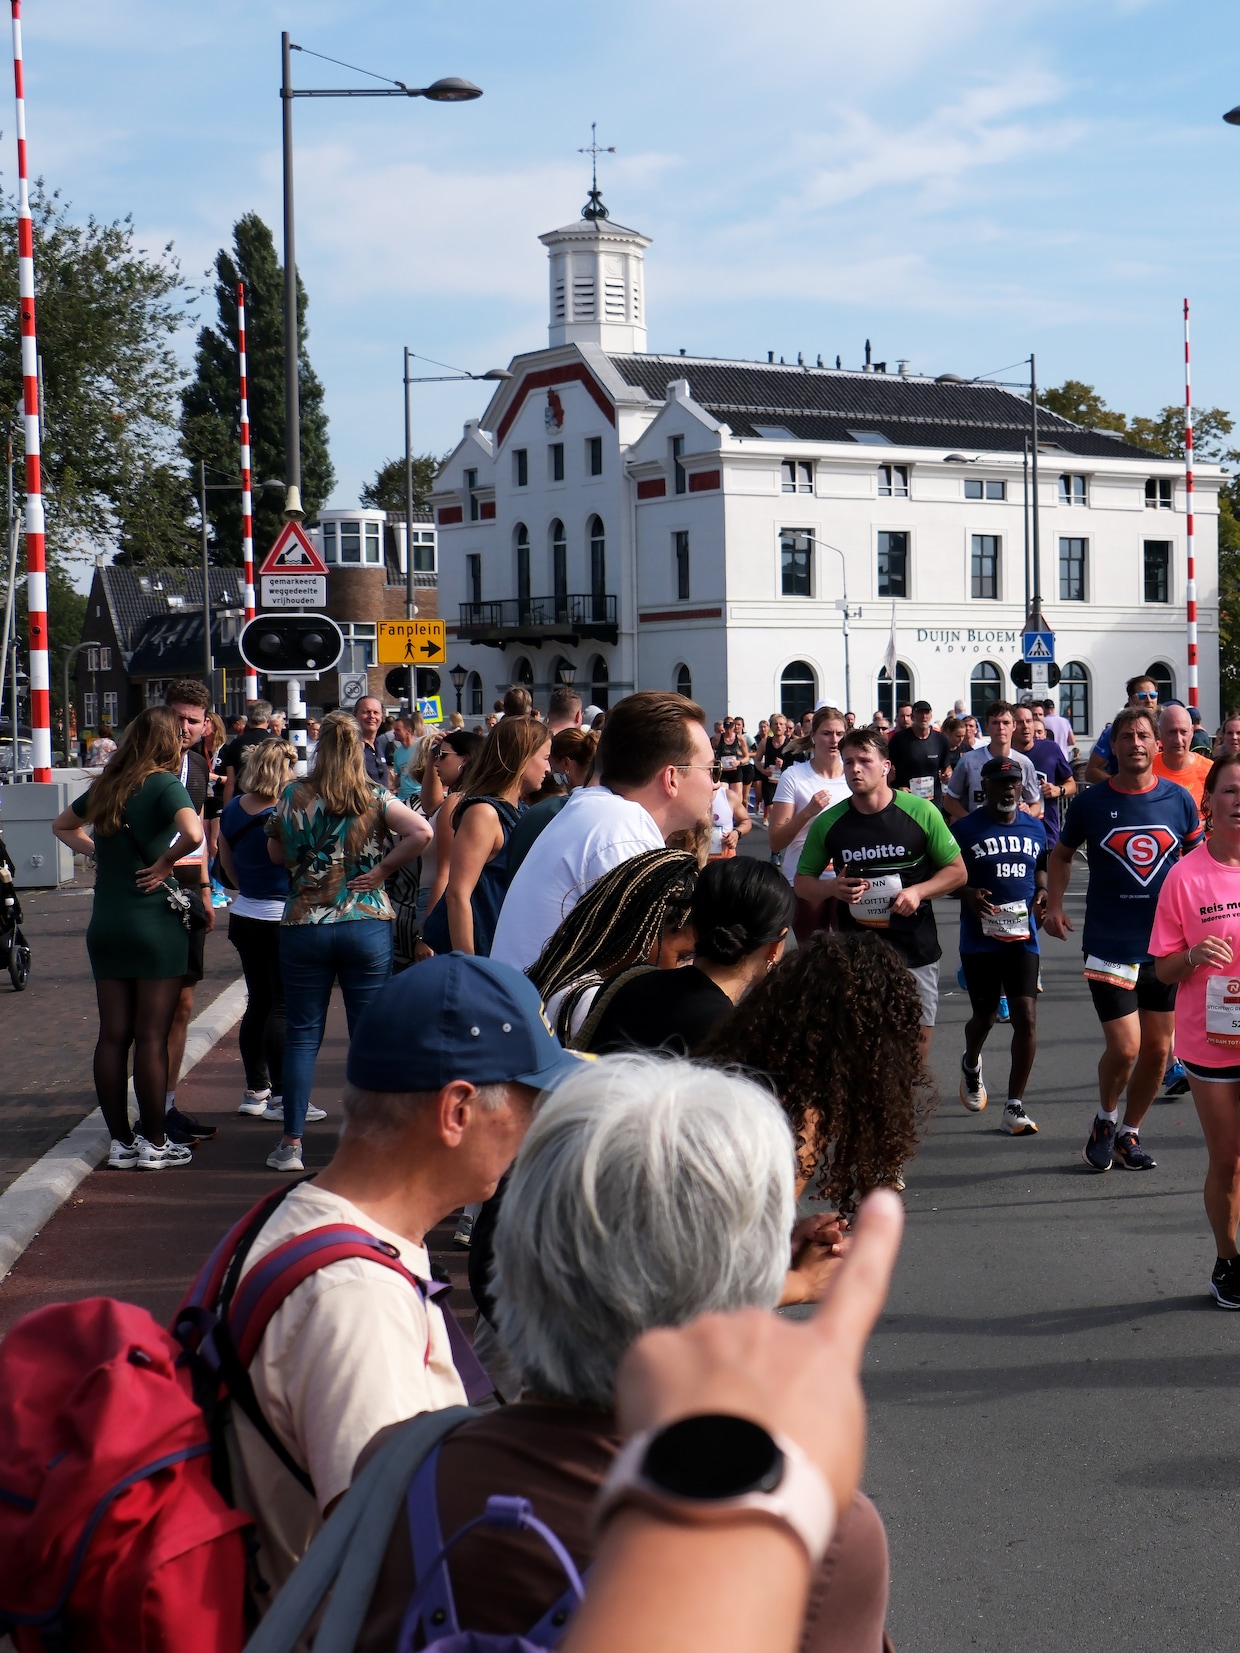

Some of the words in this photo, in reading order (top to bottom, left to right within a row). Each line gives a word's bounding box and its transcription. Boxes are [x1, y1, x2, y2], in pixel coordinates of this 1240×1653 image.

[272, 598, 314, 606] vrijhouden
[380, 624, 440, 637] Fanplein
[968, 629, 1016, 642] BLOEM
[970, 836, 1040, 860] ADIDAS
[1132, 838, 1153, 862] S
[996, 863, 1026, 878] 1949
[856, 897, 888, 906] LOITTE
[1200, 903, 1224, 915] Reis
[1201, 914, 1230, 924] Iedereen
